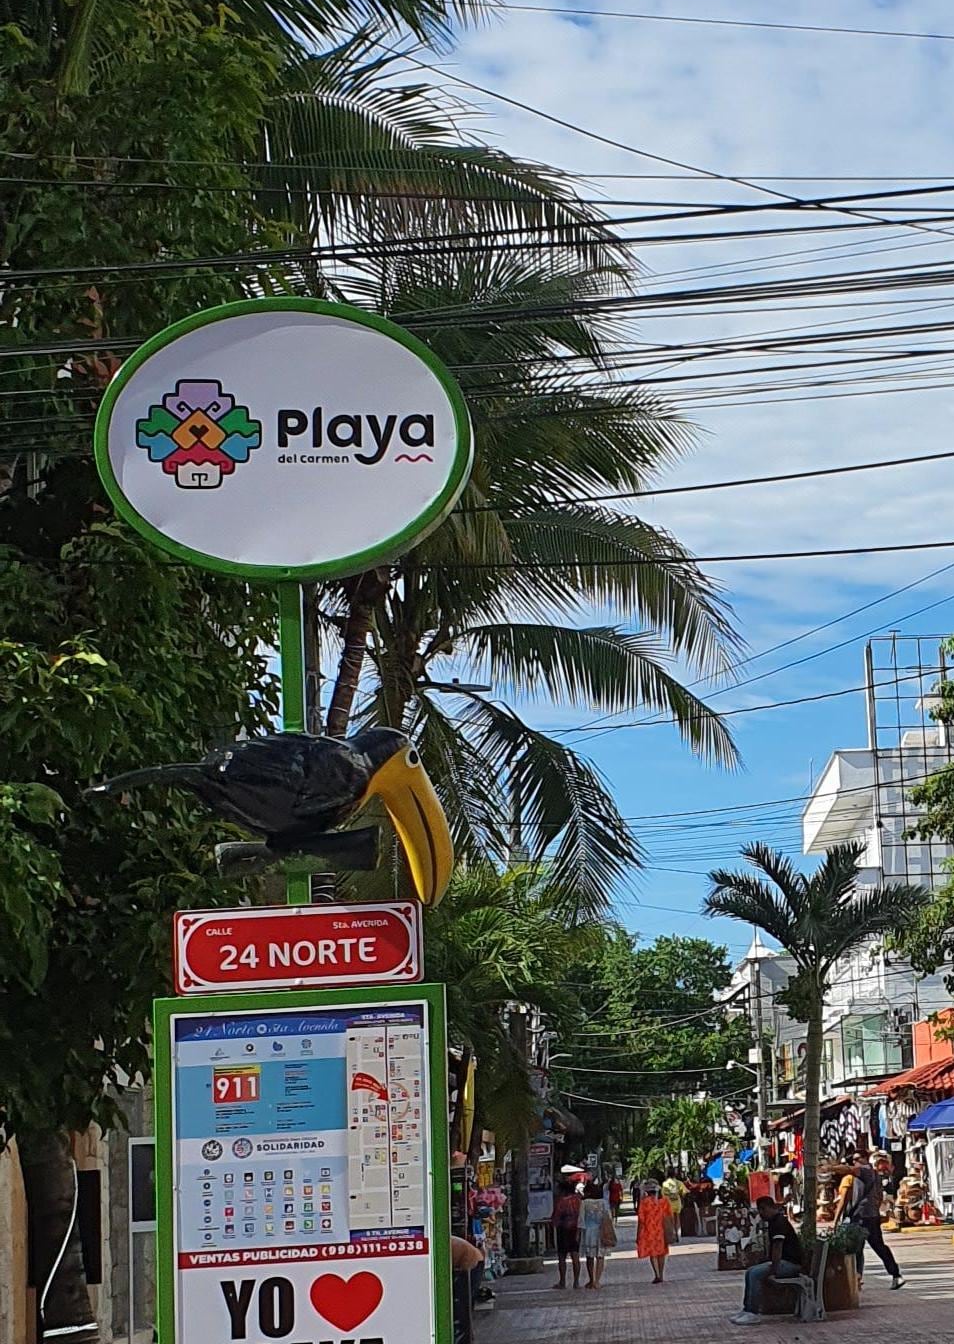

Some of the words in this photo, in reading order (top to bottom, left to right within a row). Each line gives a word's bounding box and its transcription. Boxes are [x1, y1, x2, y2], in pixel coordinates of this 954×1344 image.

[277, 406, 435, 465] Playa
[278, 454, 297, 464] del
[206, 927, 233, 937] CALLE
[351, 919, 389, 929] AVENIDA
[219, 943, 259, 971] 24
[268, 937, 378, 968] NORTE
[216, 1075, 257, 1100] 911
[256, 1140, 325, 1152] SOLIDARIDAD
[190, 1253, 240, 1265] VENTAS
[242, 1248, 318, 1262] PUBLICIDAD
[321, 1241, 424, 1257] (998)111-0338
[220, 1276, 295, 1340] YO
